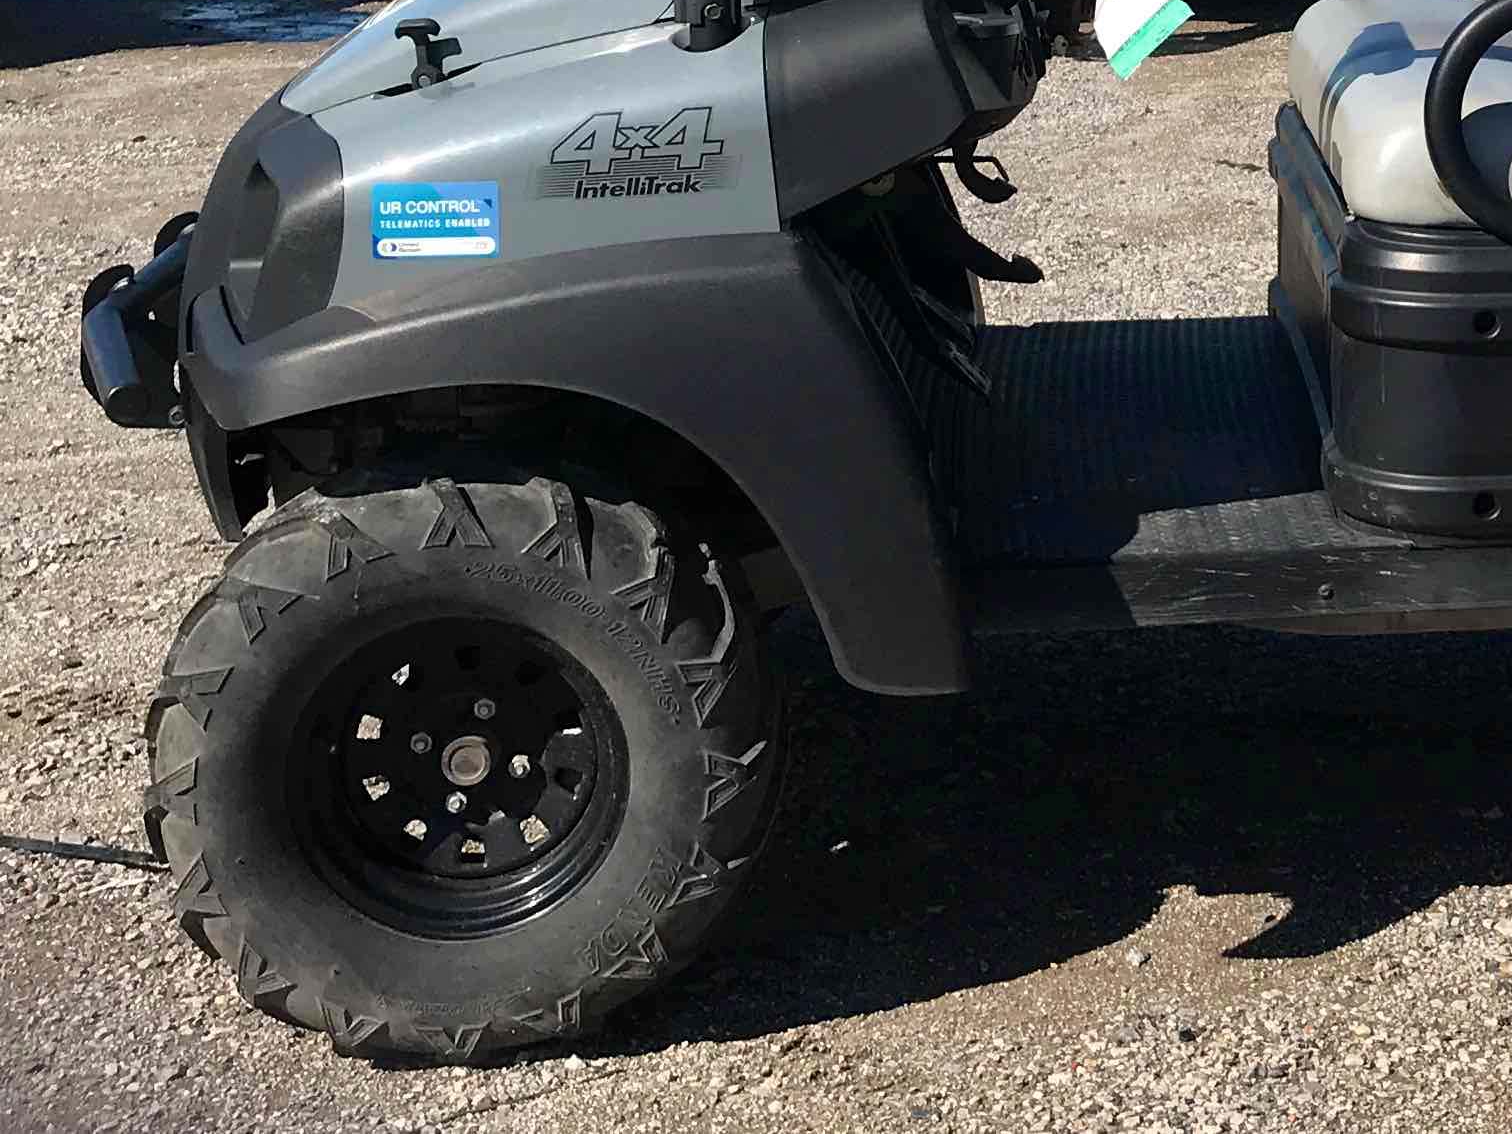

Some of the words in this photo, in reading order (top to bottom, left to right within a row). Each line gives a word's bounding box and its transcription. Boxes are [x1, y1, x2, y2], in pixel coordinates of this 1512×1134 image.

[550, 106, 724, 175] 4x4
[574, 176, 704, 200] IntelliTrak
[380, 201, 402, 215] UR
[405, 199, 481, 214] CONTROL
[380, 219, 441, 229] TELEMATICS
[444, 217, 491, 228] ENABLED
